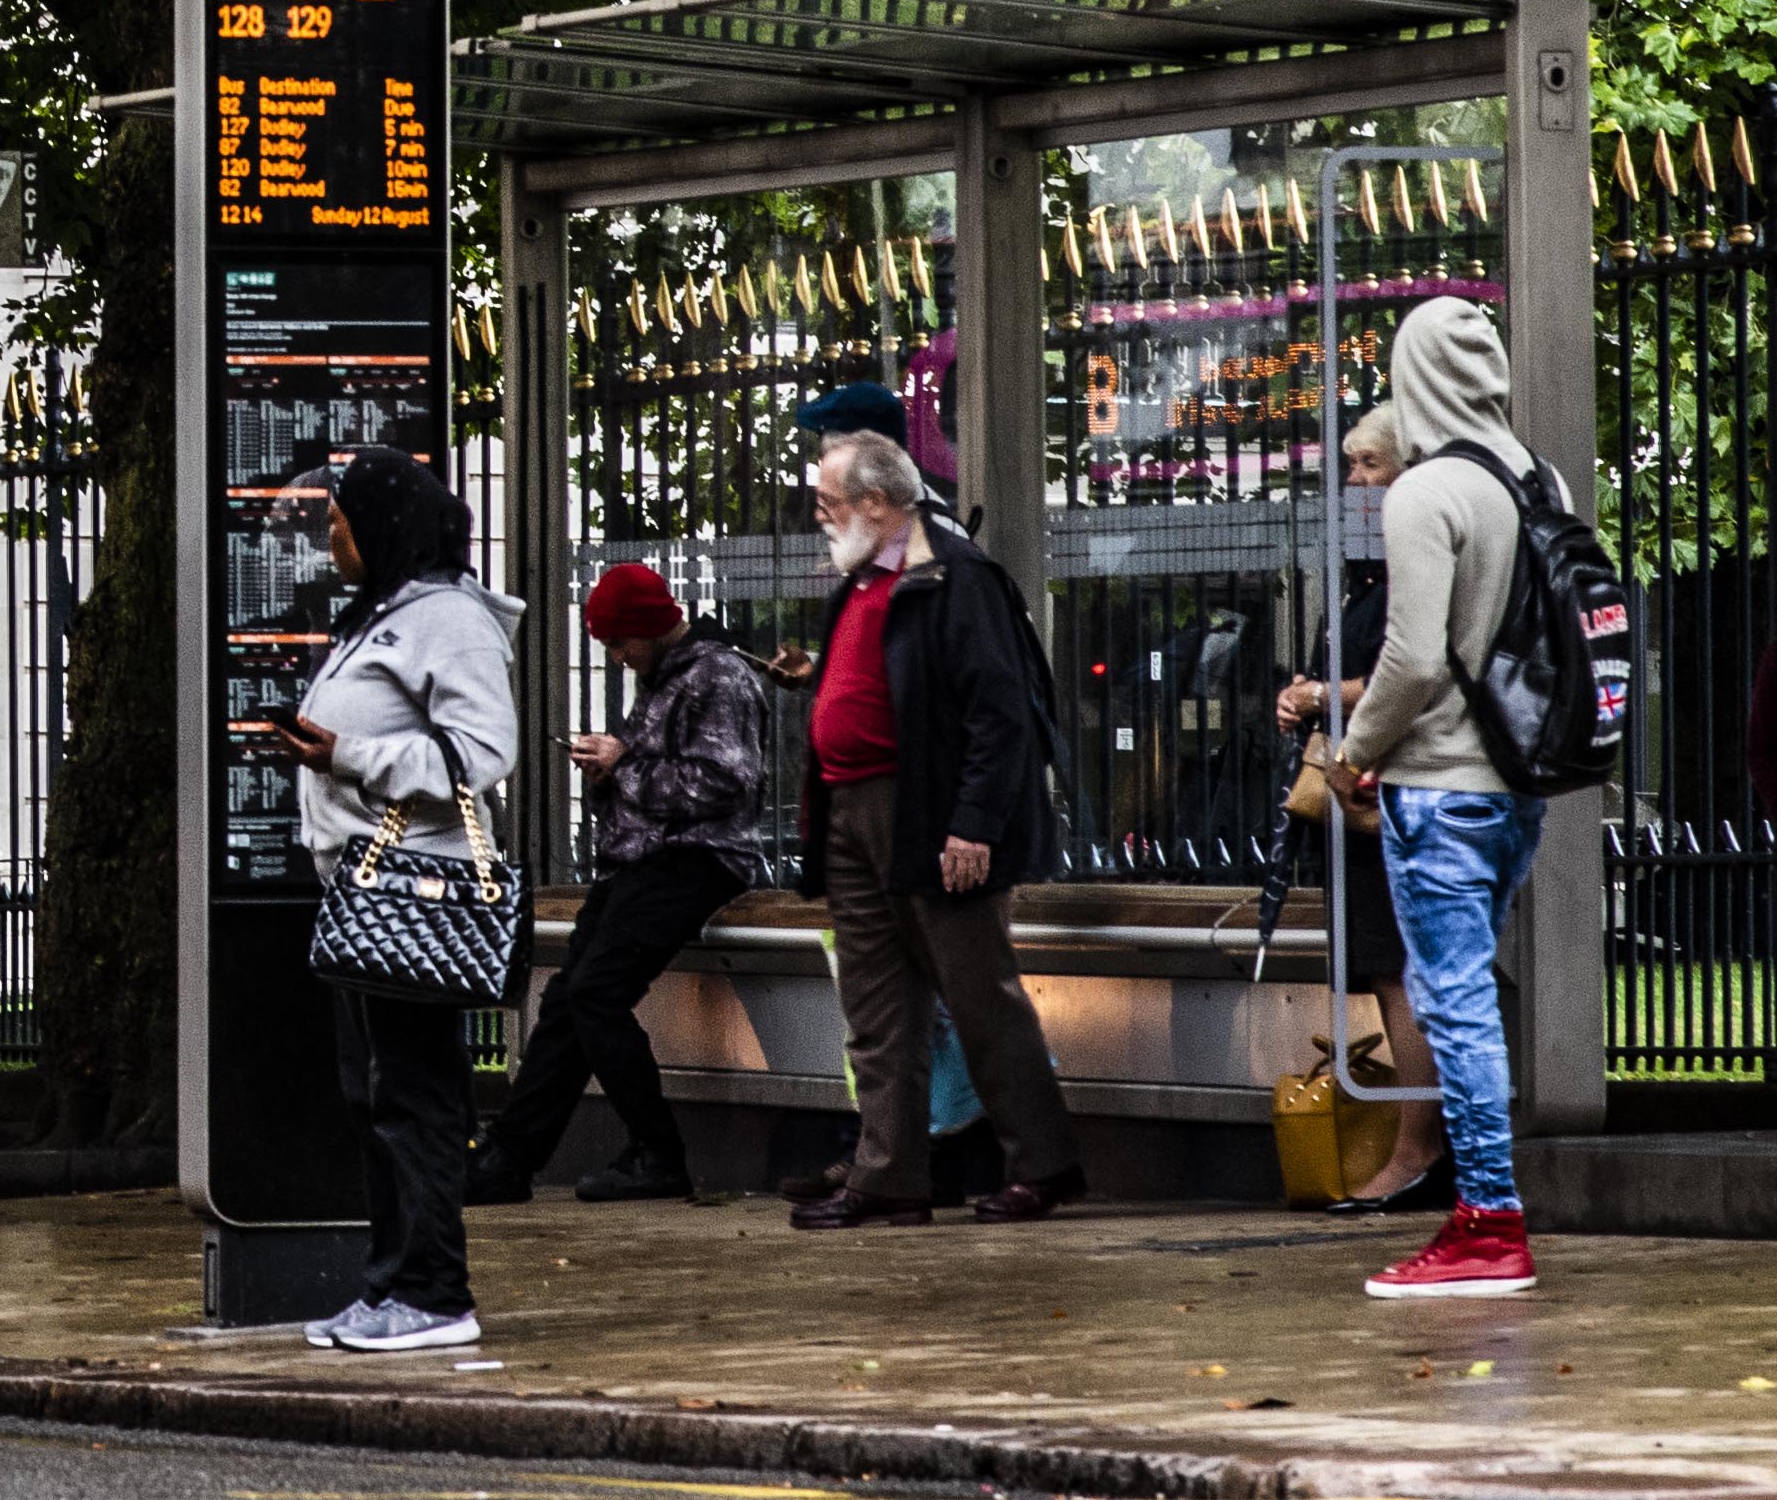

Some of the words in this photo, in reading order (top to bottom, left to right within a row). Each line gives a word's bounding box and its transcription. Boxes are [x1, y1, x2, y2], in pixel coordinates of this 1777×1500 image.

[218, 4, 266, 38] 128
[287, 5, 333, 39] 129
[218, 76, 245, 96] Bus
[259, 76, 337, 96] Destination
[385, 78, 414, 97] Time
[218, 97, 241, 116] 82
[259, 96, 326, 117] Bearwood
[384, 98, 415, 117] Due
[221, 117, 250, 136] 127
[259, 117, 307, 139] Dudley
[218, 137, 241, 156] 87
[259, 137, 307, 160] Dudley
[384, 139, 397, 158] 7
[221, 158, 250, 177] 120
[259, 158, 307, 180] Dudley
[218, 178, 241, 197] 82
[259, 179, 326, 198] Bearwood
[312, 205, 362, 228] Sunday
[364, 206, 381, 225] 12
[382, 206, 430, 229] August
